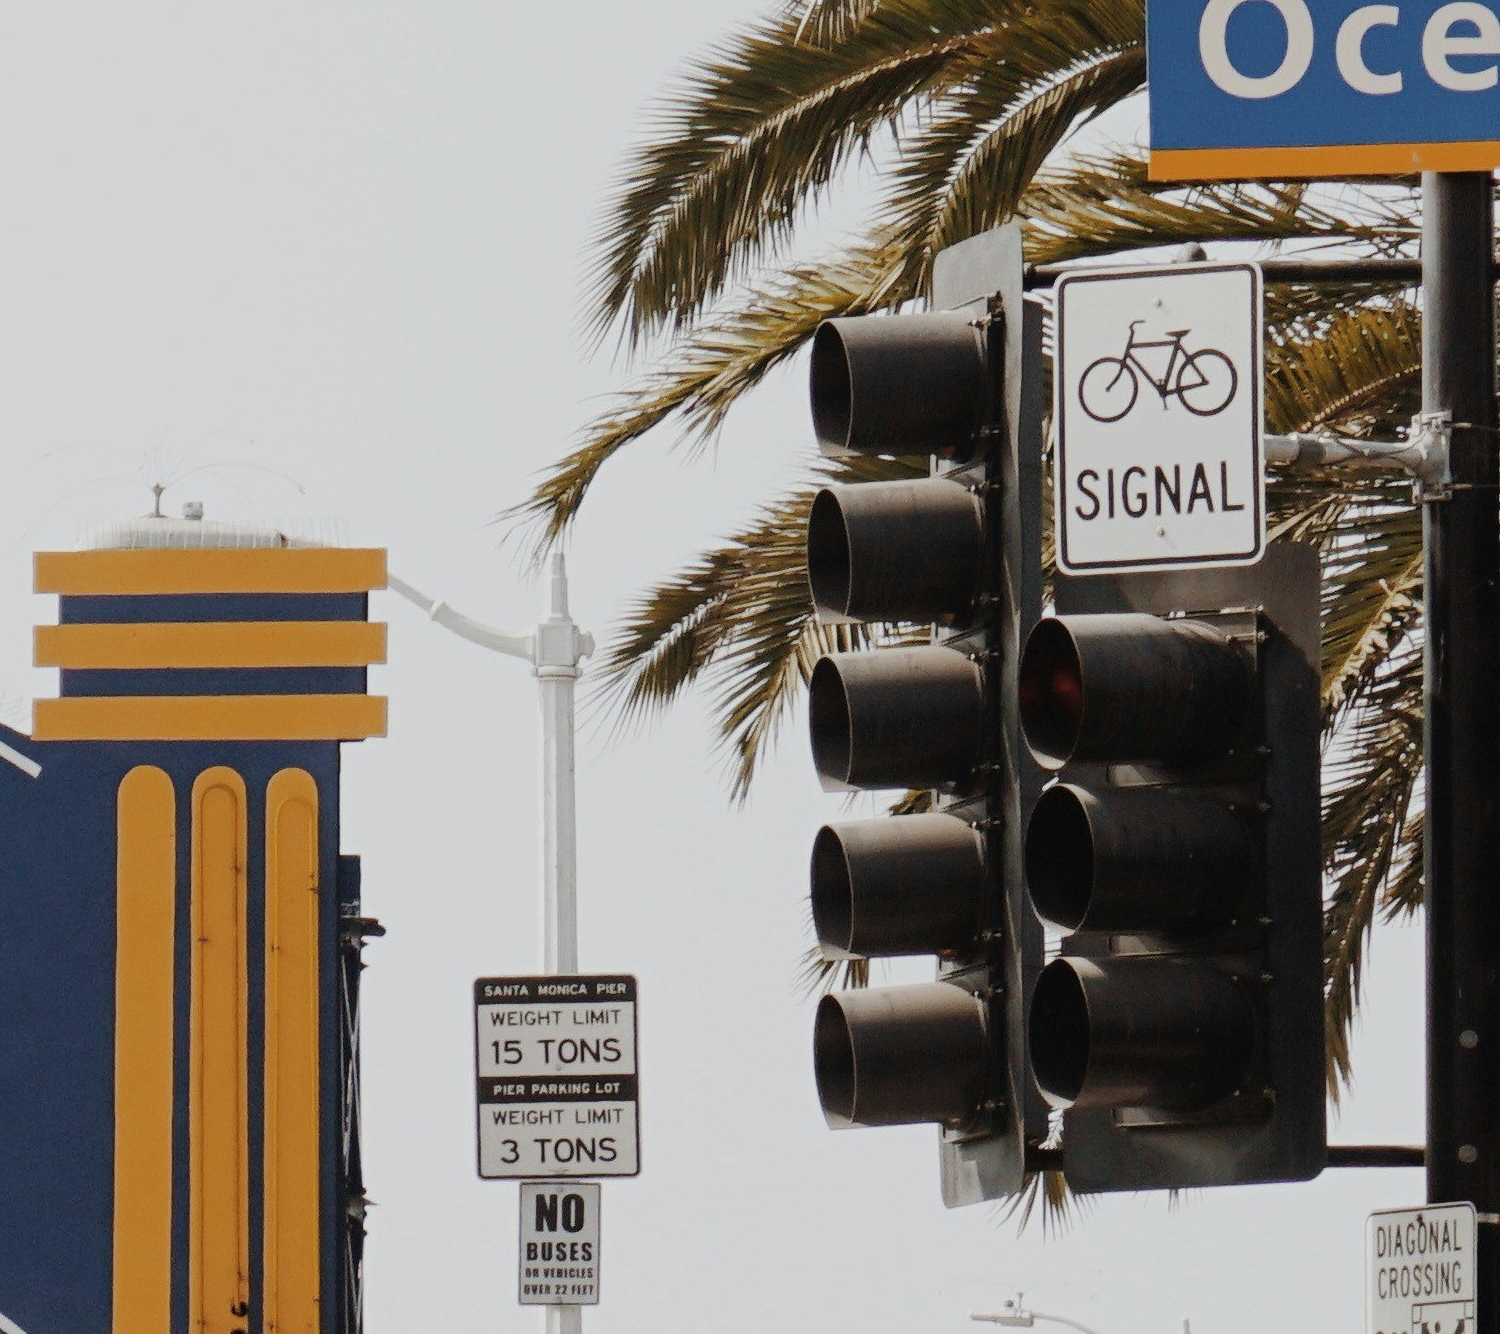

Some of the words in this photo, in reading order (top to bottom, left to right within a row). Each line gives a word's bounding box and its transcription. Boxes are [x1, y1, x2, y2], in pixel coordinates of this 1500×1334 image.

[1075, 460, 1245, 521] SIGNAL
[484, 984, 529, 997] SANTA
[538, 983, 588, 996] MONICA
[596, 982, 627, 995] PIER
[490, 1010, 563, 1027] WEIGHT
[573, 1009, 621, 1025] LIMIT
[491, 1040, 523, 1065] 15
[537, 1038, 622, 1064] TONS
[493, 1084, 525, 1096] PIER
[531, 1083, 591, 1095] PARKING
[595, 1082, 621, 1094] LOT
[492, 1110, 565, 1125] WEIGHT
[575, 1108, 624, 1124] LIMIT
[500, 1139, 520, 1164] 3
[534, 1137, 618, 1163] TONS
[535, 1193, 585, 1233] NO
[1376, 1219, 1462, 1258] DIAGONAL
[526, 1242, 593, 1262] BUSES
[543, 1268, 594, 1278] VEHICLES
[1378, 1260, 1462, 1300] CROSSING
[523, 1284, 551, 1295] OVER
[555, 1284, 568, 1295] 22
[571, 1284, 594, 1295] FEET
